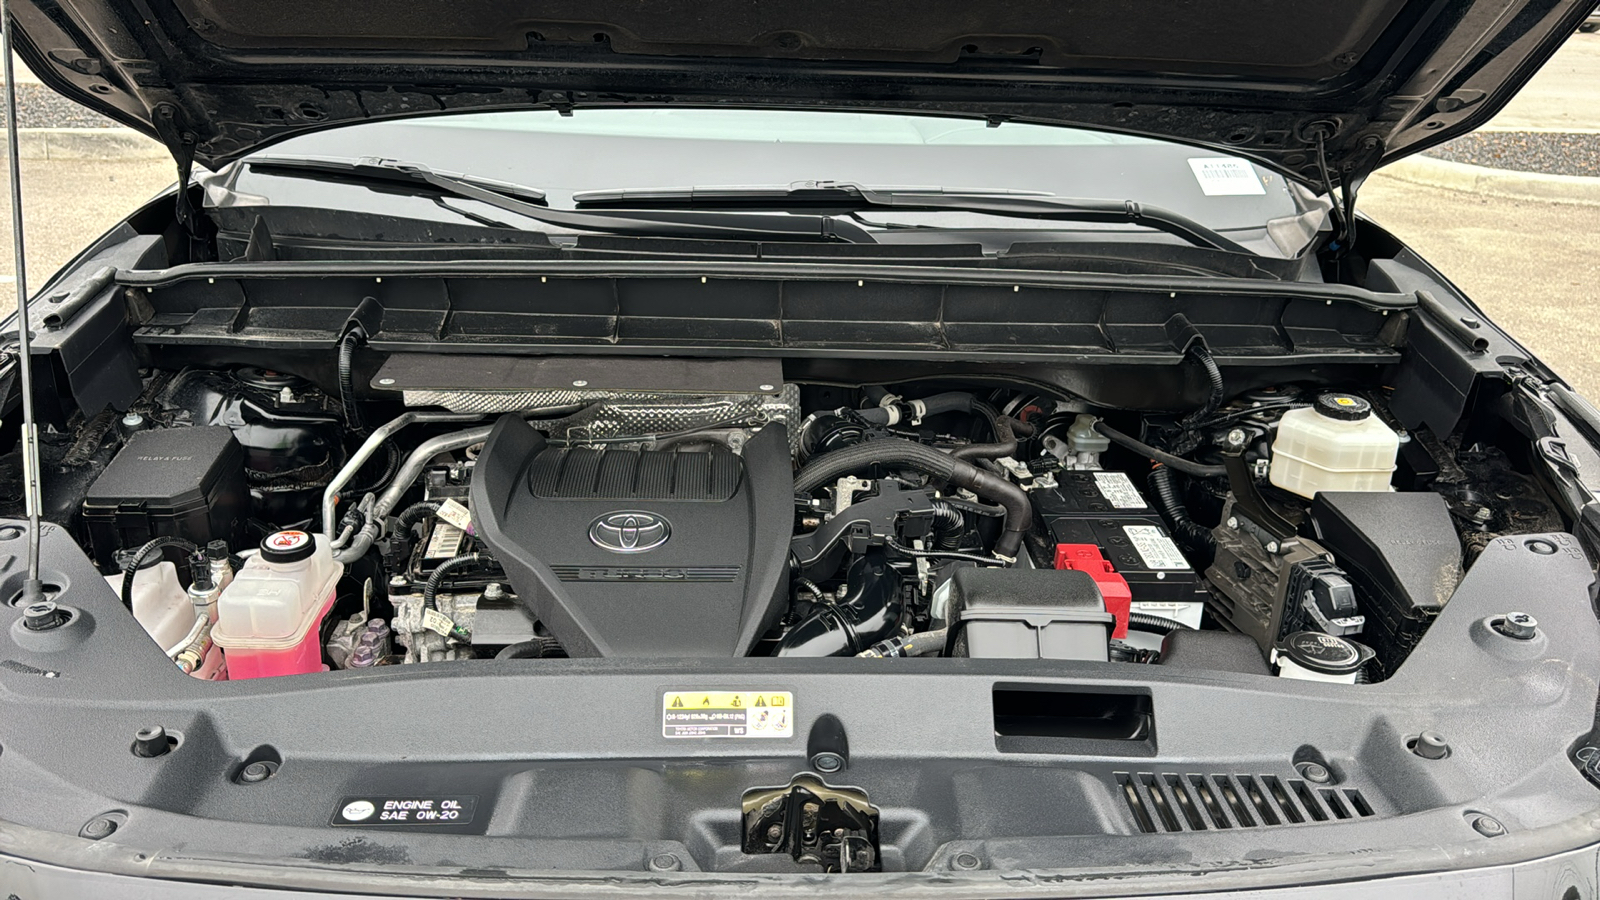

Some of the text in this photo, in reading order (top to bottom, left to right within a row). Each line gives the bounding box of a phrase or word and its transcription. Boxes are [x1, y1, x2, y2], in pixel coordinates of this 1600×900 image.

[383, 800, 462, 810] ENGINE OIL
[380, 810, 459, 820] SAE 0W-20
